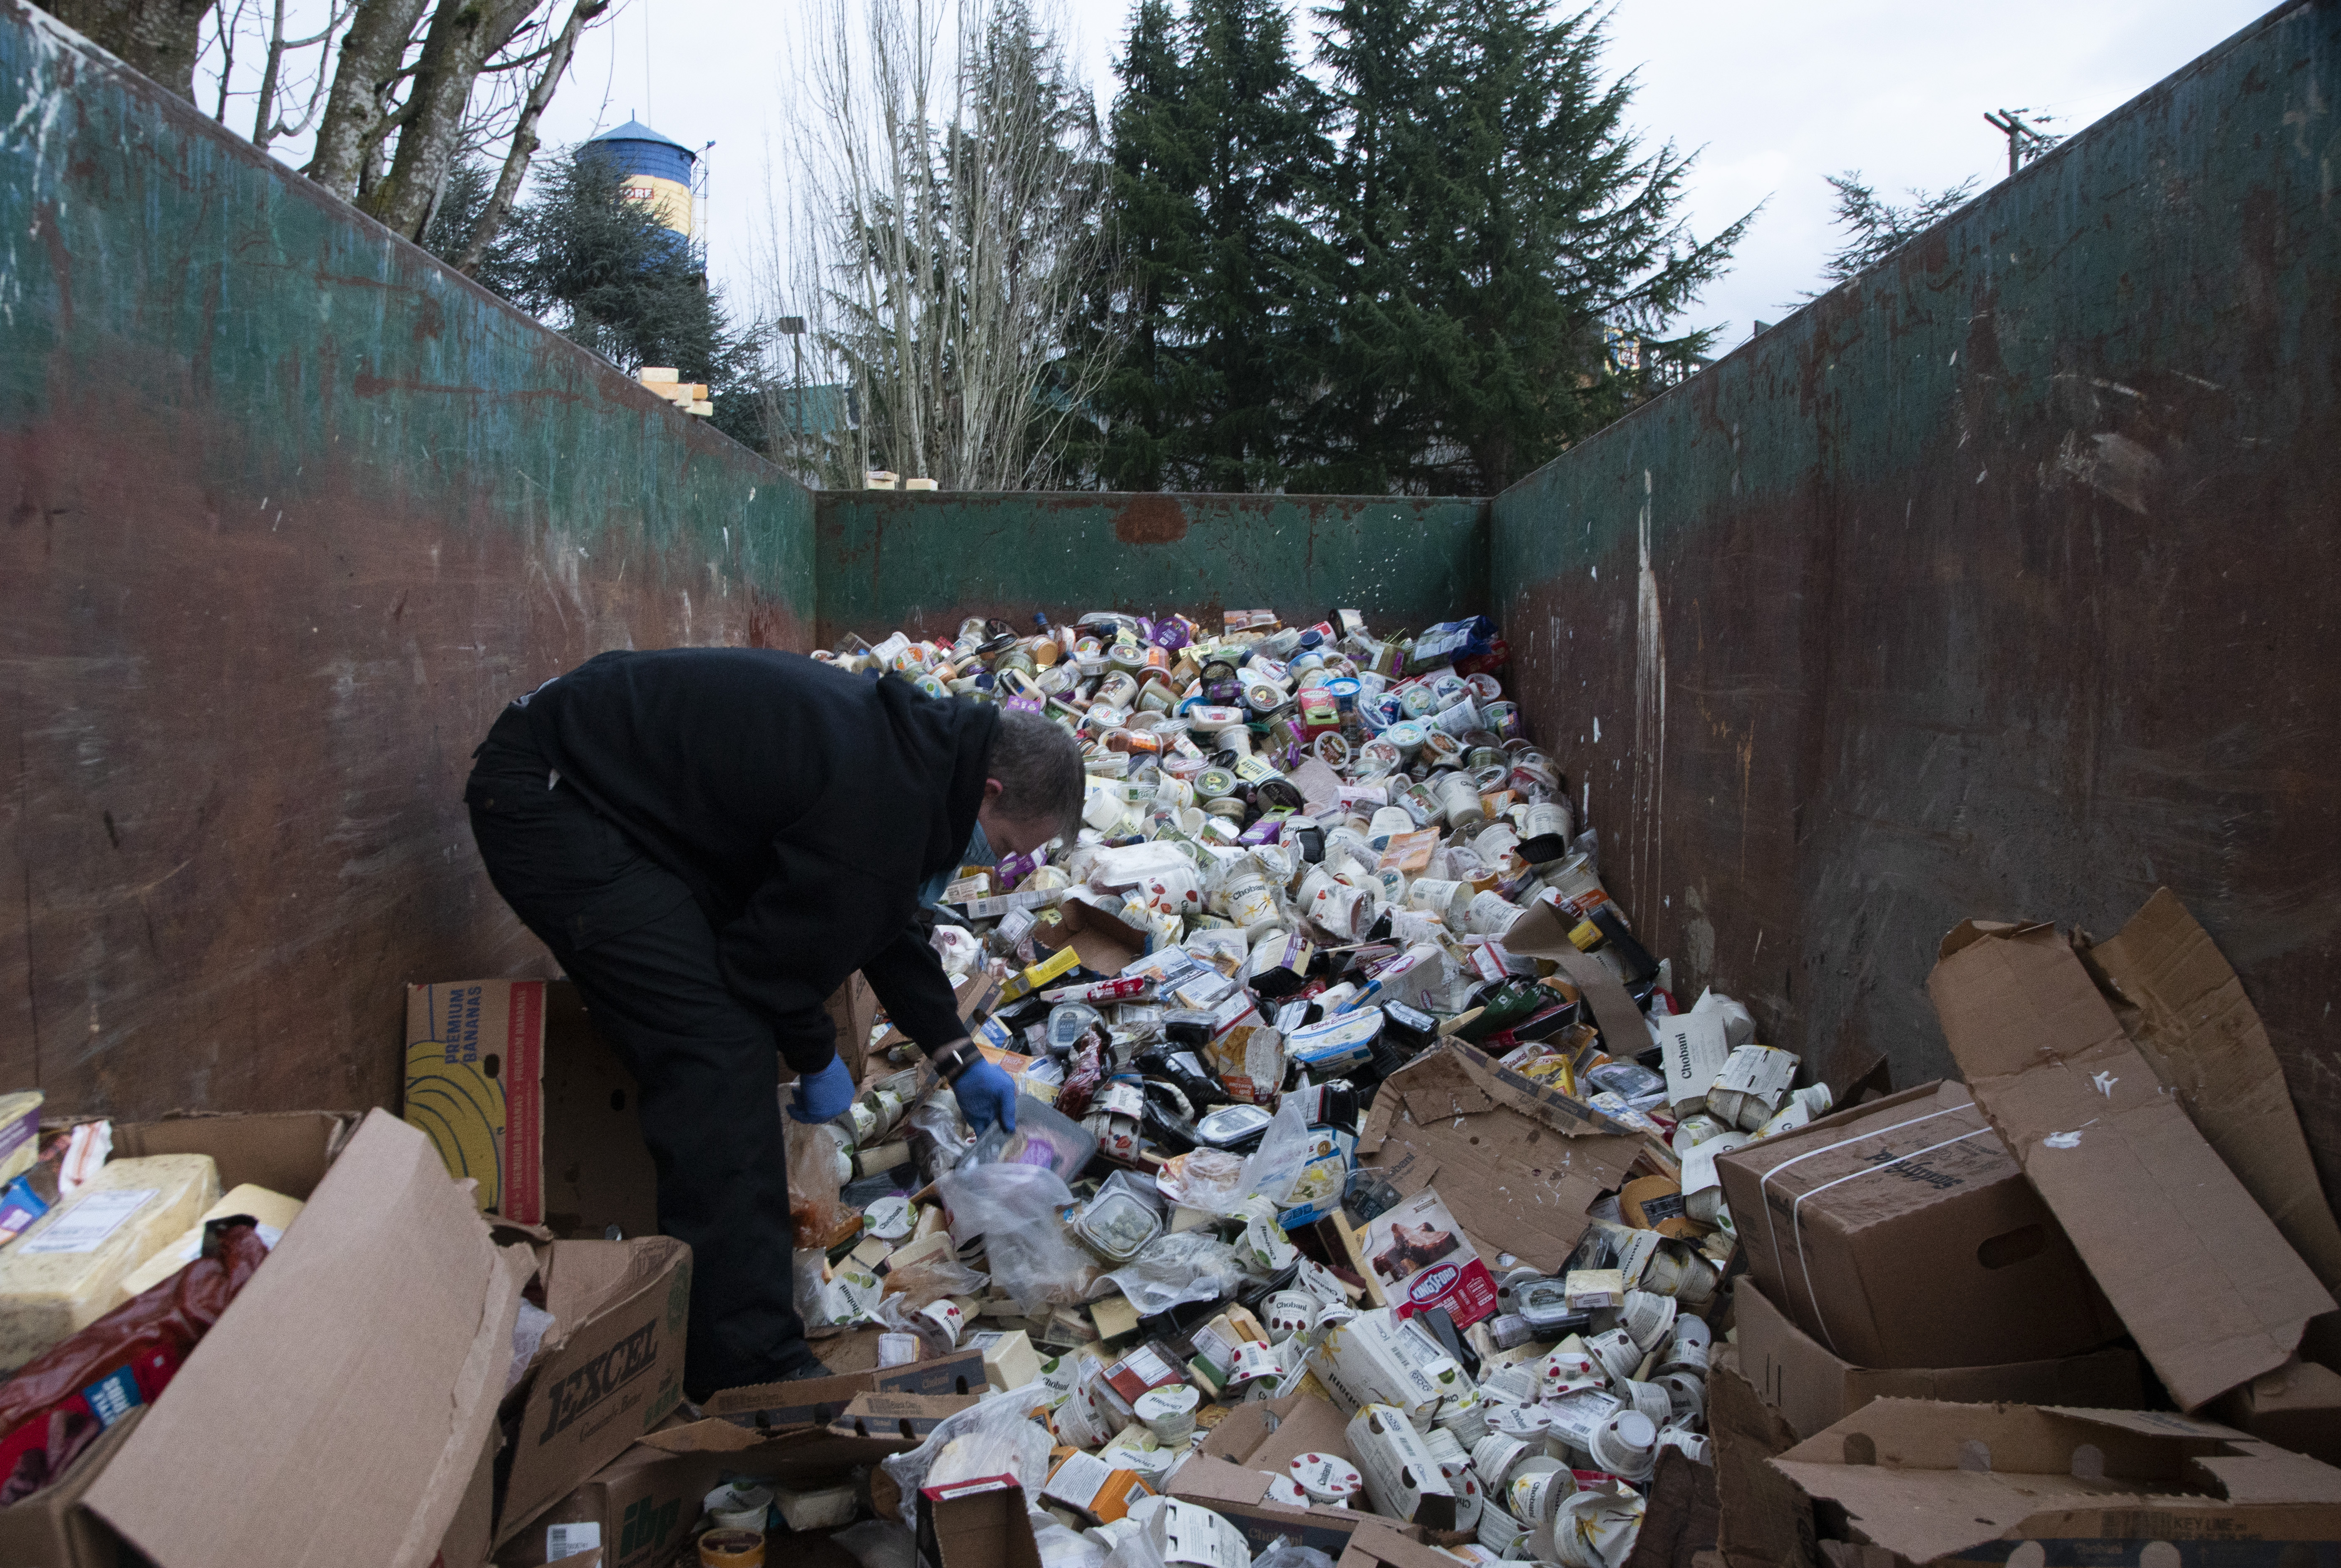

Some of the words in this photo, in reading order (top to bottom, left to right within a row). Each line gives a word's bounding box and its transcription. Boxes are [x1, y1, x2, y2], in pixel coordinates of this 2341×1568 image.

[1242, 761, 1264, 775] BUTTER
[1232, 885, 1266, 900] Chobani
[445, 988, 464, 1064] PREMIUM
[463, 986, 482, 1063] BANANAS
[517, 990, 527, 1039] BANANAS
[1310, 1021, 1329, 1031] Bob
[1330, 1012, 1359, 1026] Evans
[1676, 1032, 1692, 1079] Chobani
[513, 1095, 524, 1143] BANANAS
[513, 1144, 523, 1190] PREMIUM
[879, 1206, 903, 1230] Chobani
[1260, 1225, 1277, 1260] Chobani
[1412, 1265, 1457, 1300] KINGSFORD
[1276, 1301, 1307, 1311] Chobani
[540, 1320, 659, 1446] EXCEL
[1042, 1377, 1070, 1391] Chobani
[1148, 1396, 1183, 1410] Chobani
[1510, 1409, 1529, 1429] Chobani
[1120, 1451, 1156, 1469] Chobani
[1318, 1461, 1332, 1485] Chobani
[1529, 1481, 1541, 1519] Chobani
[620, 1495, 681, 1559] ibp
